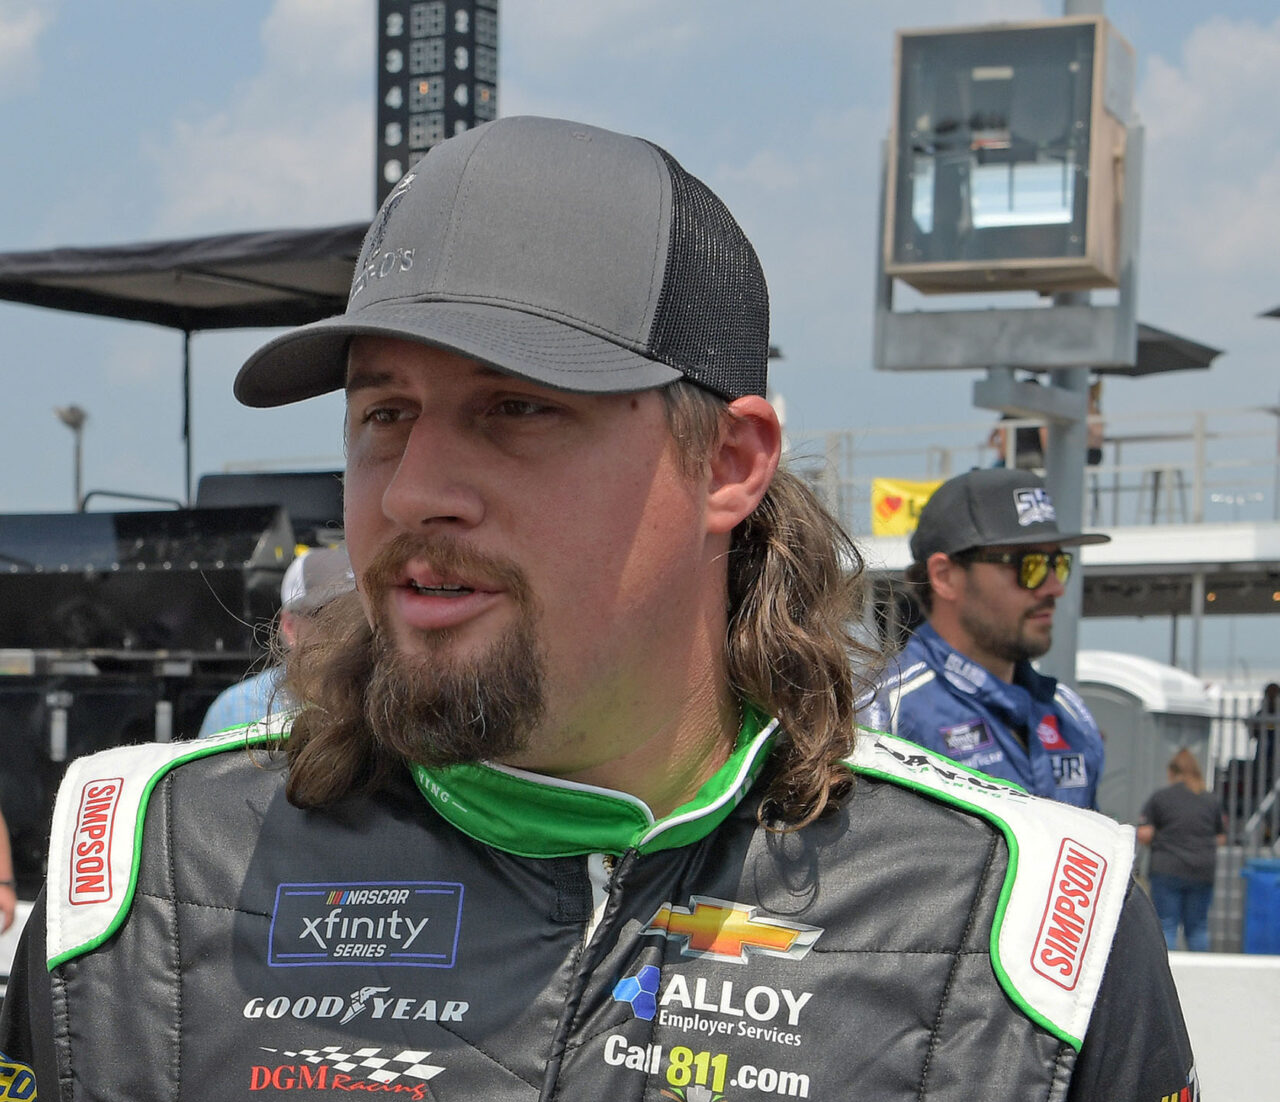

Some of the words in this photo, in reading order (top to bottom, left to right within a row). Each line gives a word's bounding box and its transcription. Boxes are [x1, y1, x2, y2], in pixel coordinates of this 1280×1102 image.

[76, 784, 116, 894] SIMPSON
[346, 889, 410, 905] NASCAR
[1040, 847, 1099, 976] SIMPSON
[299, 908, 429, 949] xfinity
[333, 943, 387, 957] SERIES
[660, 974, 813, 1026] ALLOY
[659, 1010, 734, 1036] Employer
[737, 1022, 802, 1046] Services
[604, 1034, 662, 1074] Call
[249, 1065, 329, 1090] DGM
[331, 1073, 428, 1100] Racing
